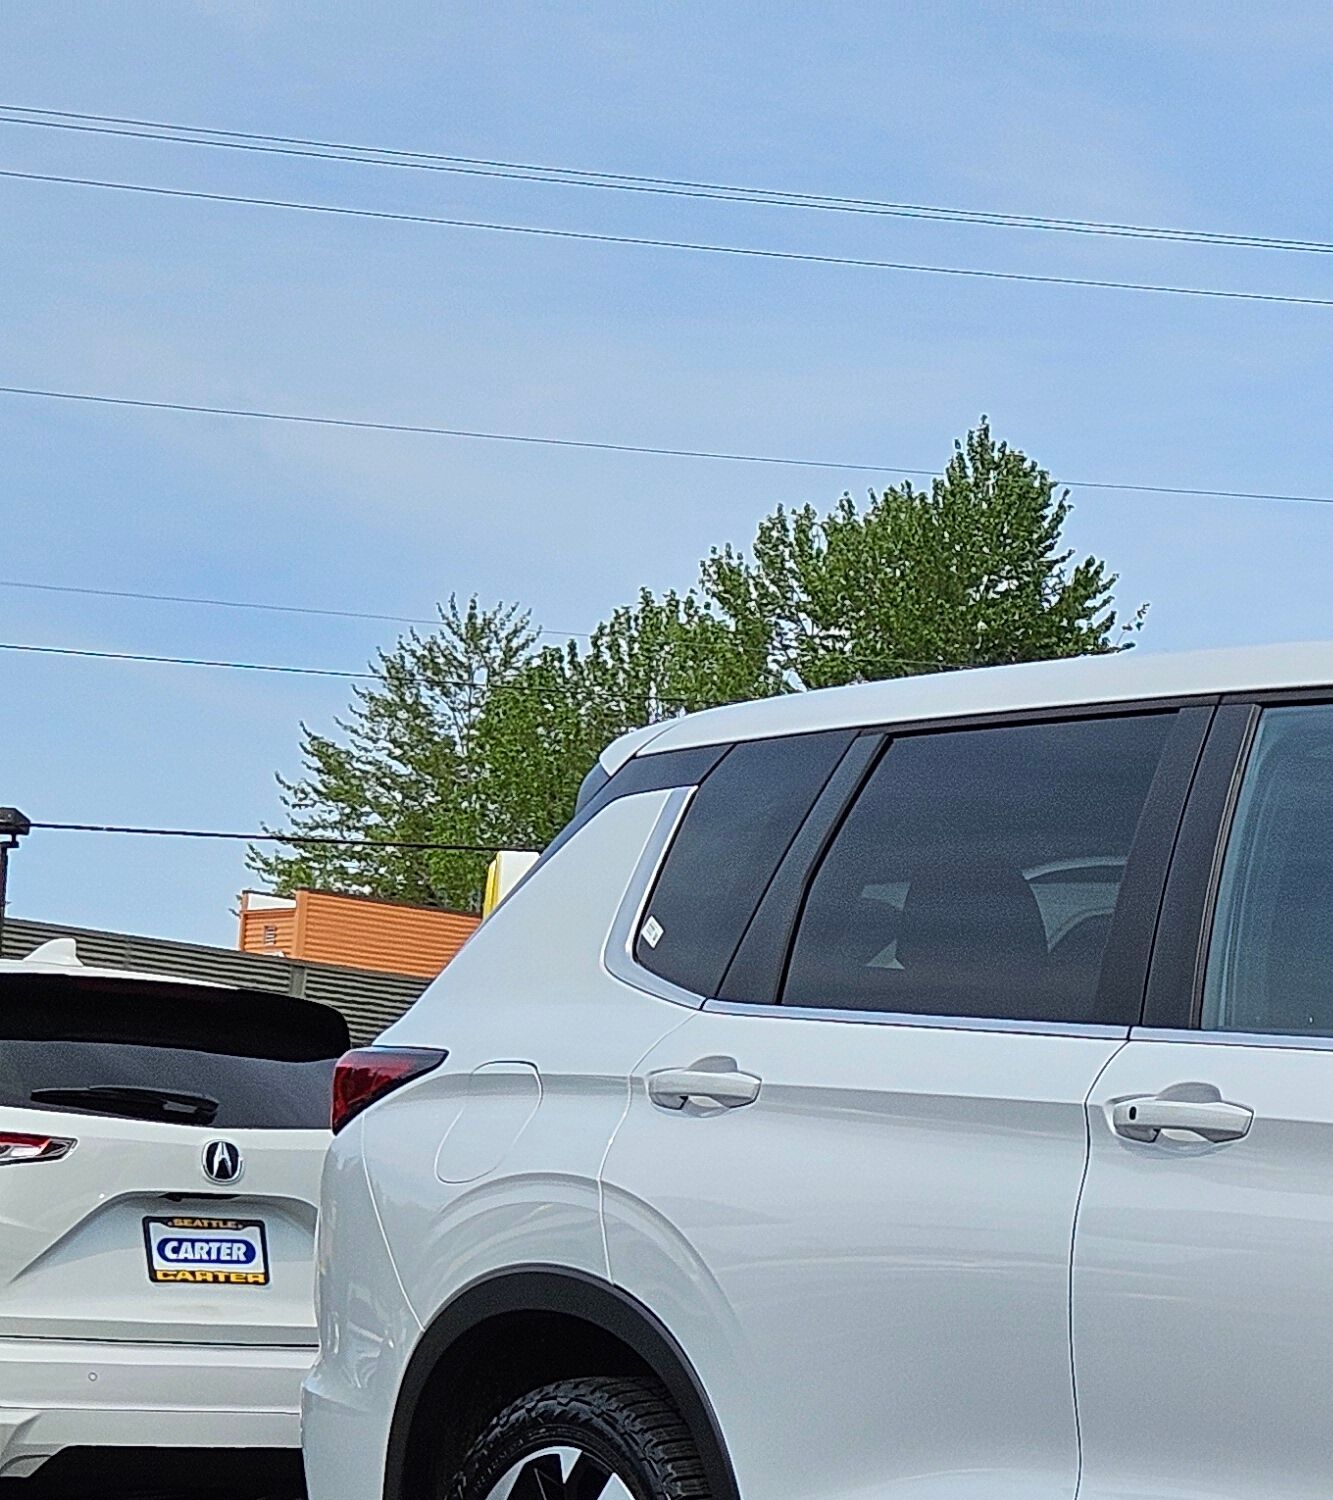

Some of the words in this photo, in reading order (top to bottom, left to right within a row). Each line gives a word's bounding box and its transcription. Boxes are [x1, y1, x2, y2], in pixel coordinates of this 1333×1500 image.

[173, 1218, 238, 1228] SEATTLE
[164, 1240, 247, 1261] CARTER
[156, 1270, 265, 1283] CARTER
